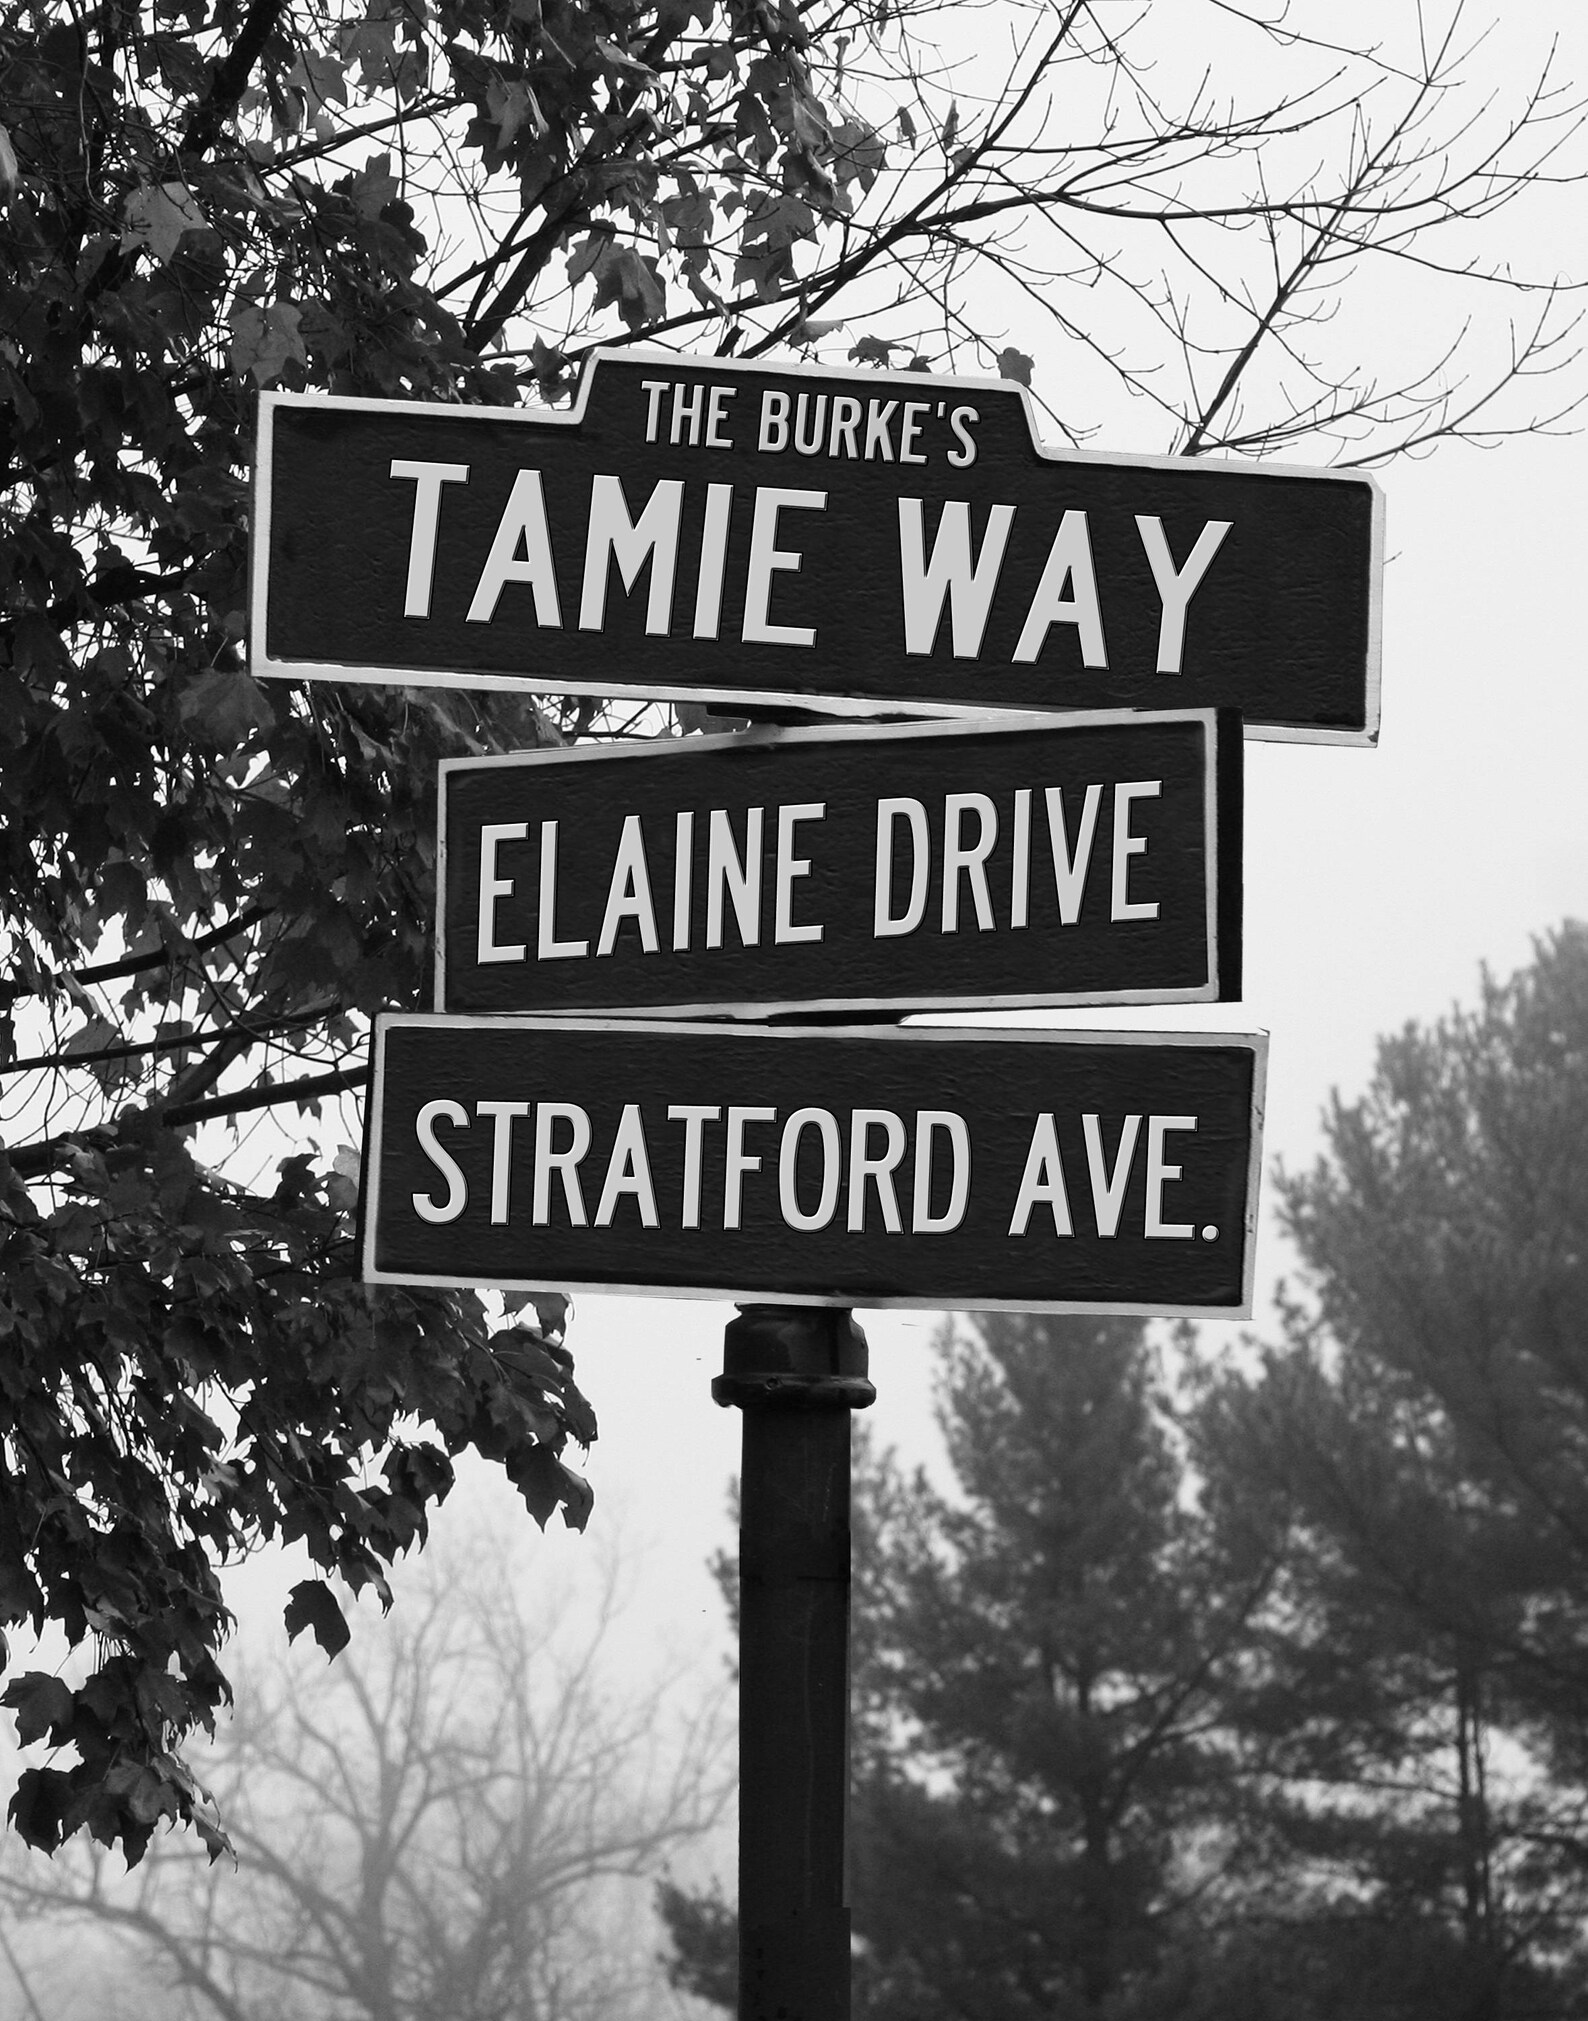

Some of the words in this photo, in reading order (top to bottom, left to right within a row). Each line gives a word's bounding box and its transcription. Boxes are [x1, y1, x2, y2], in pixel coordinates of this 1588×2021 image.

[642, 381, 736, 447] THE
[759, 391, 978, 466] BURKE'S
[390, 460, 828, 645] TAMIE
[899, 498, 1233, 673] WAY
[478, 803, 825, 964] ELAINE
[874, 781, 1161, 938] DRIVE
[413, 1100, 969, 1233] STRATFORD
[1009, 1113, 1218, 1239] AVE.
